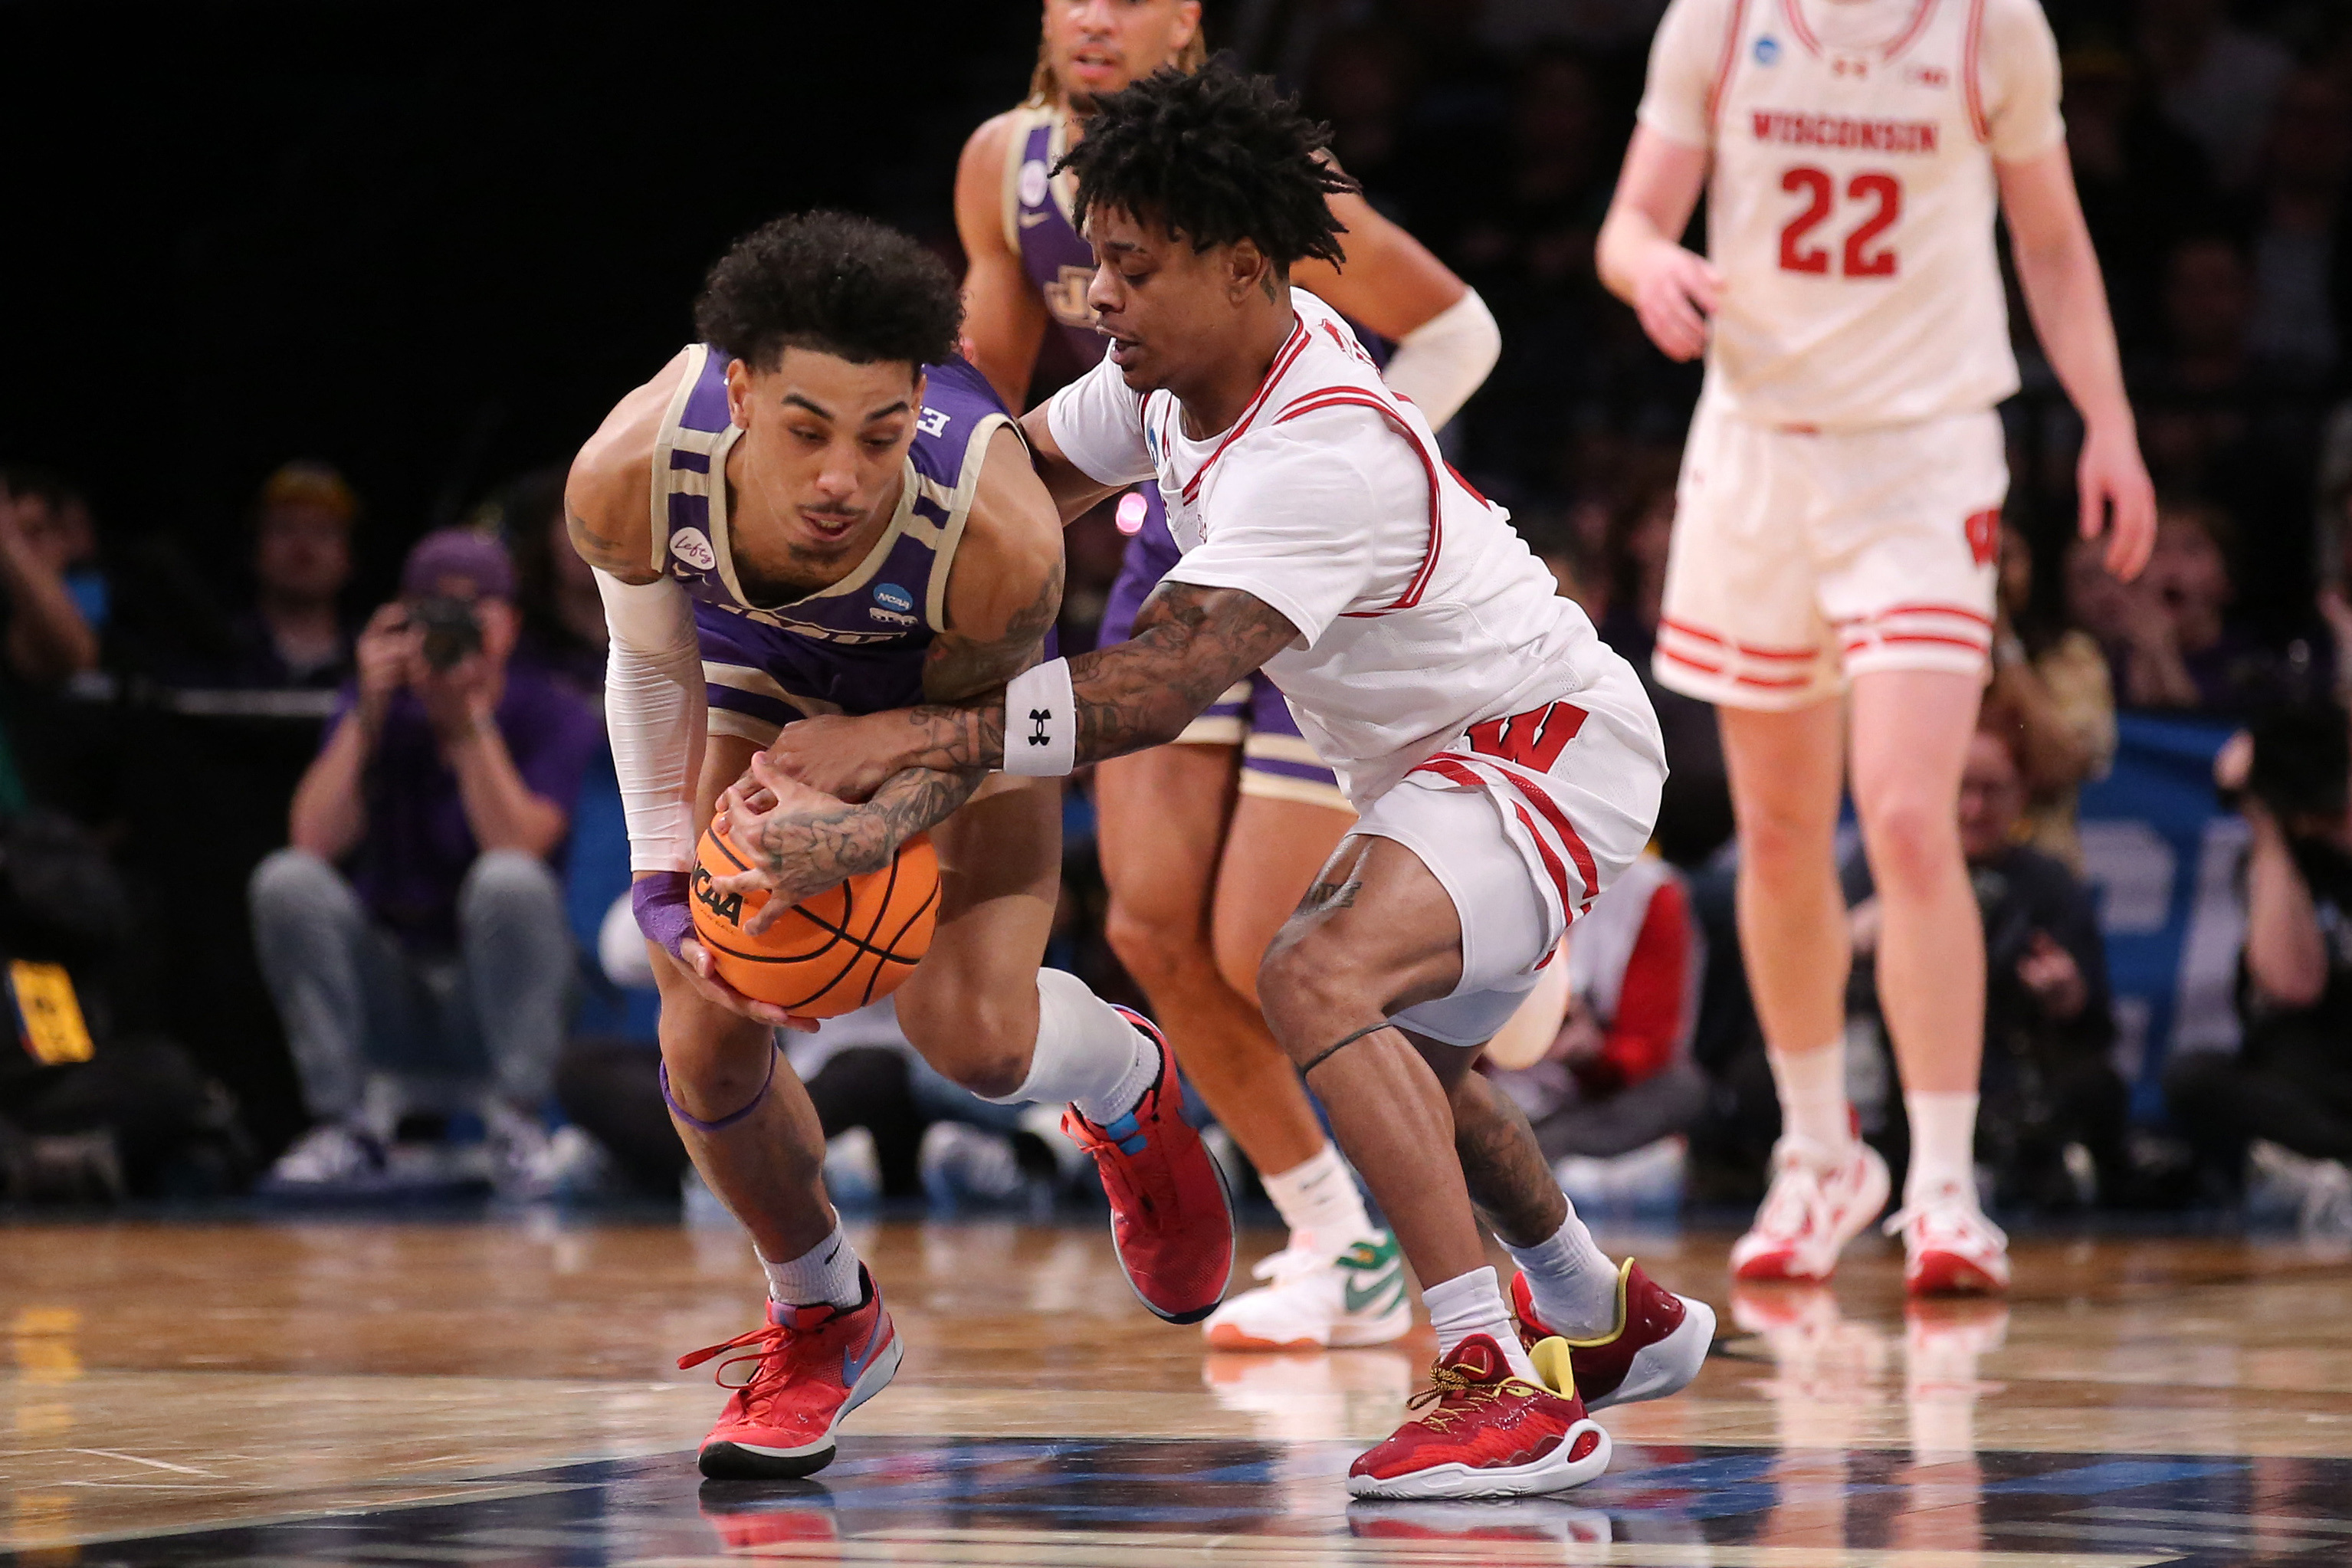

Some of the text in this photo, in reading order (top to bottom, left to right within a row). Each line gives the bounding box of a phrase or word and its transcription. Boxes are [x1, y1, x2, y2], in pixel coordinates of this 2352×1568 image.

[1750, 112, 1939, 153] WISCONSIN
[1778, 166, 1903, 278] 22
[1042, 264, 1097, 328] J
[675, 534, 712, 565] Lefty
[877, 592, 911, 610] NCAA
[1463, 700, 1589, 773] W
